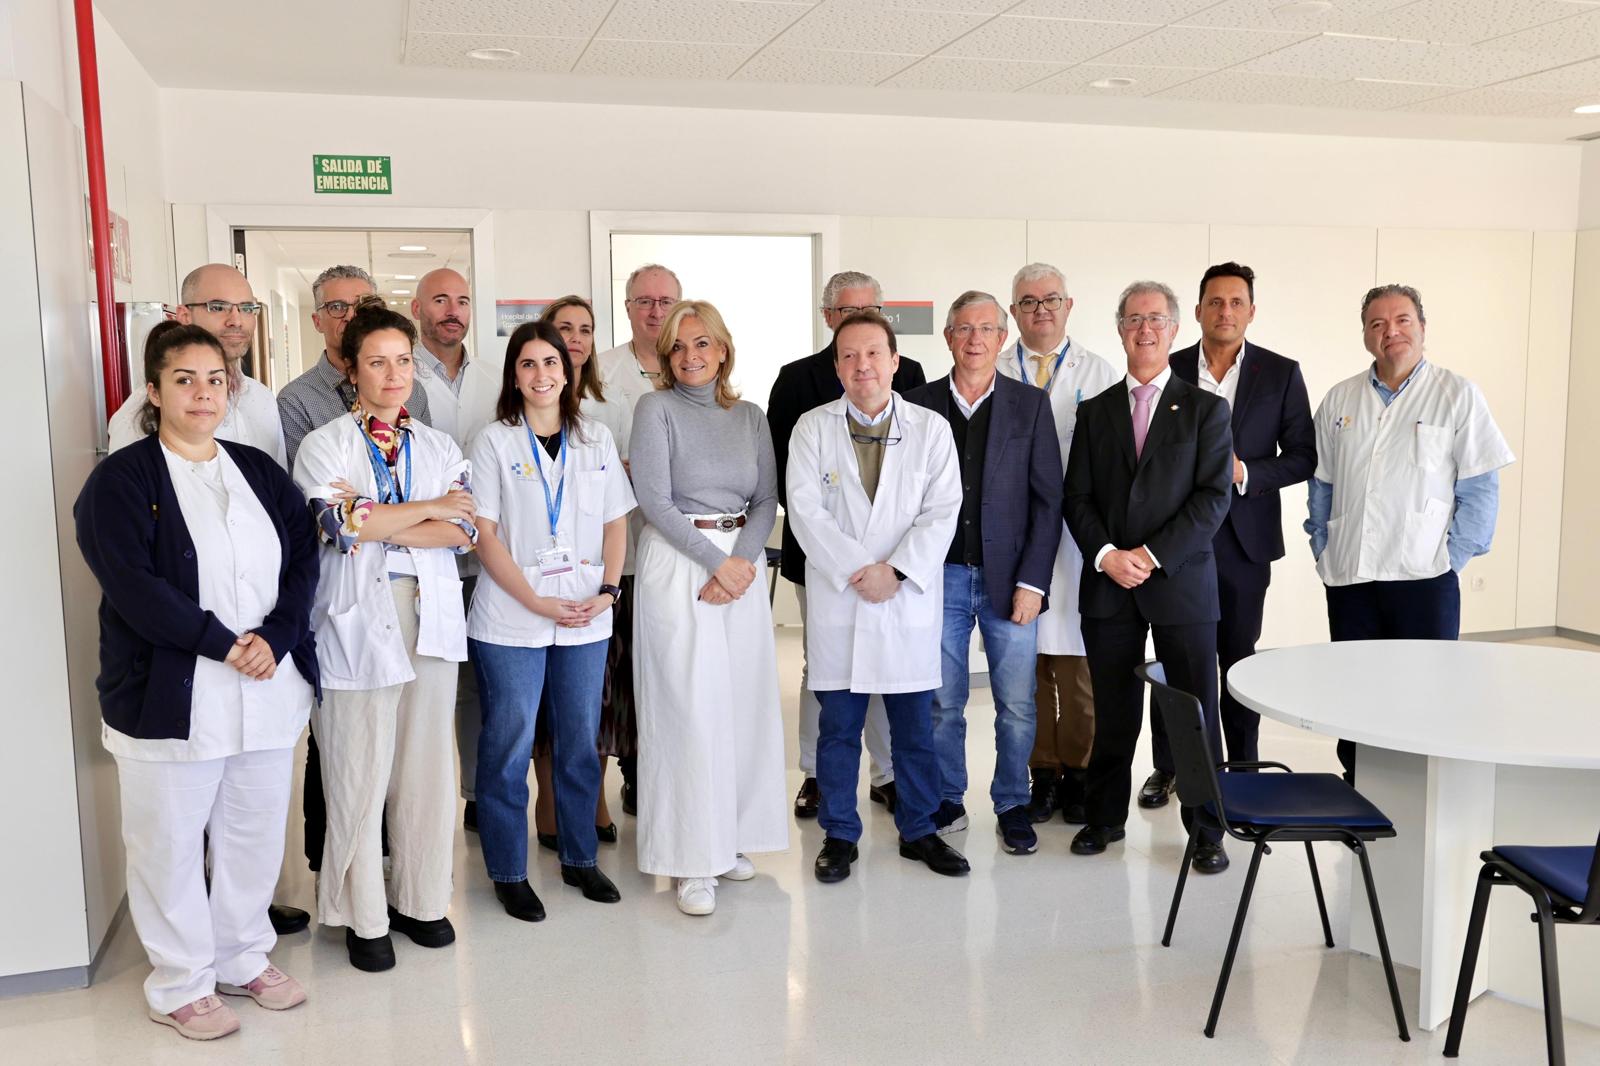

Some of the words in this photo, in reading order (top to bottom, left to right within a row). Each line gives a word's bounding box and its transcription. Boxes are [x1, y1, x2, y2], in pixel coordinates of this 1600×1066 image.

[321, 159, 363, 173] SALIDA
[367, 160, 383, 173] DE
[316, 175, 389, 190] EMERGENCIA
